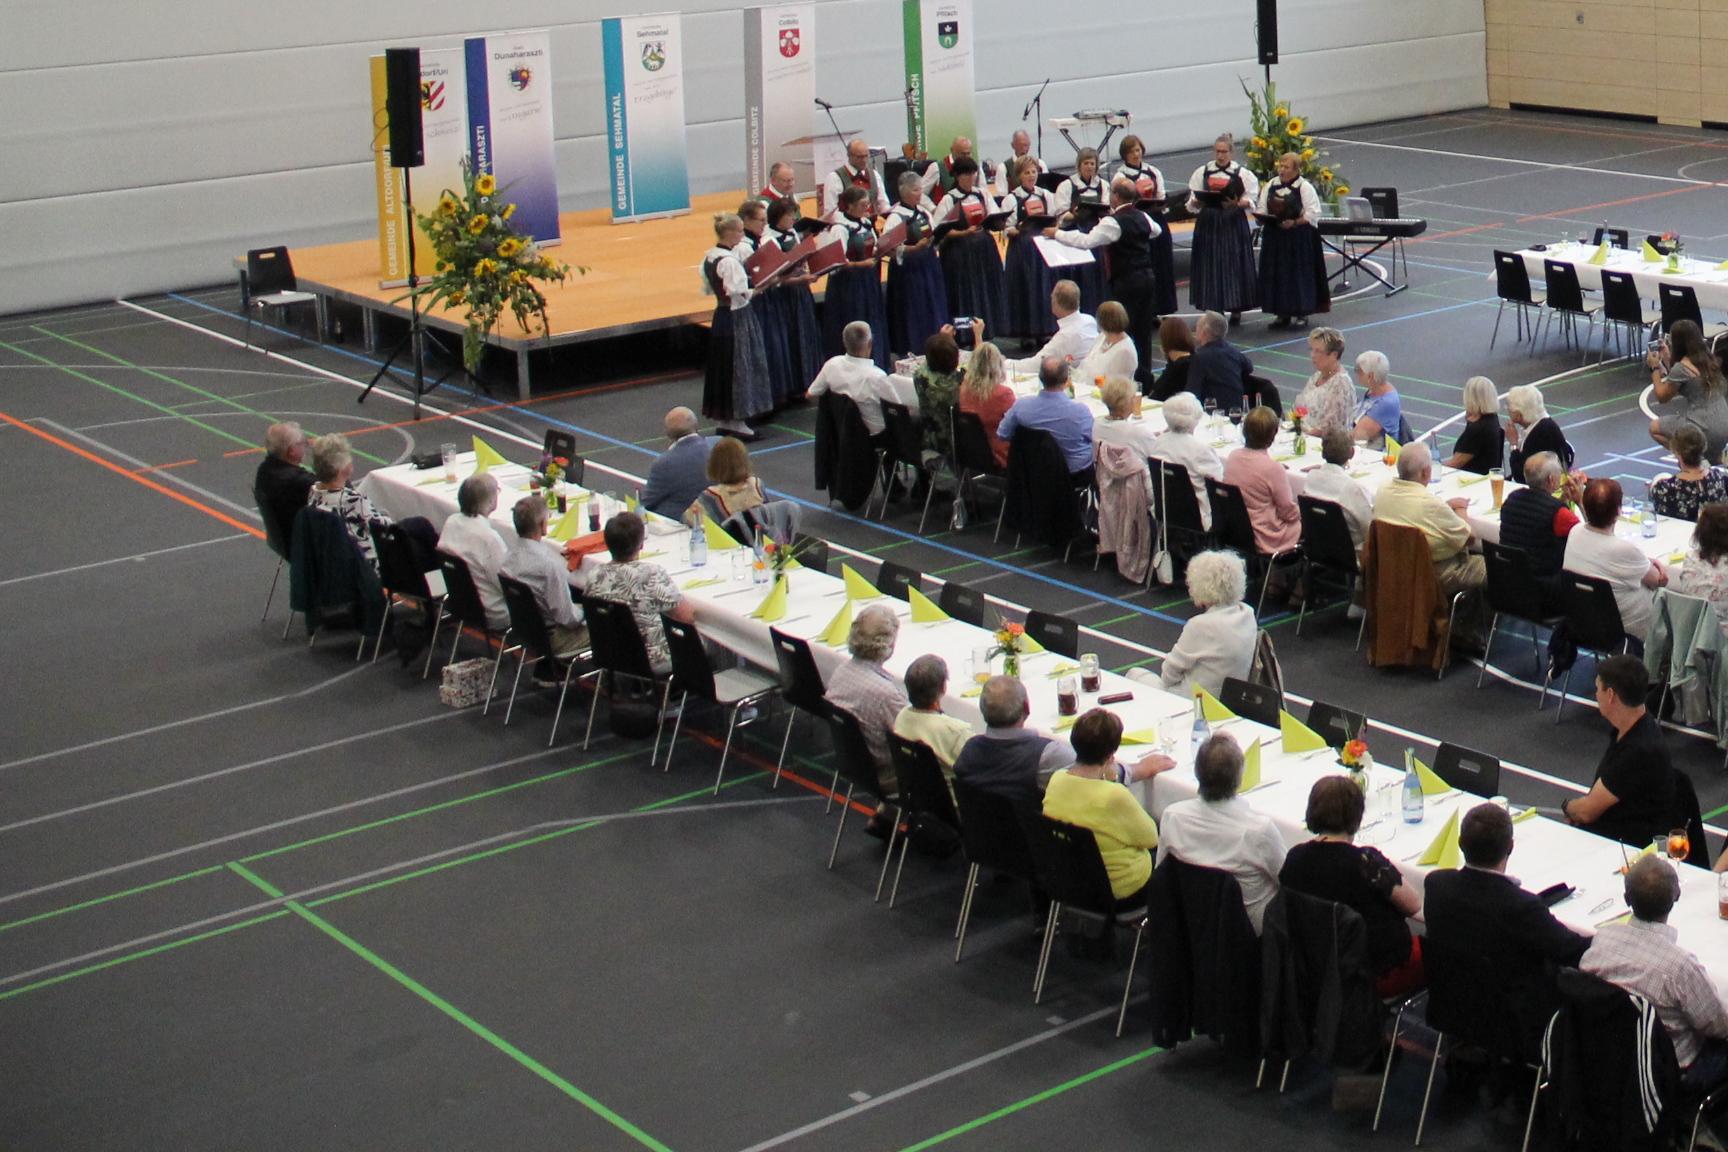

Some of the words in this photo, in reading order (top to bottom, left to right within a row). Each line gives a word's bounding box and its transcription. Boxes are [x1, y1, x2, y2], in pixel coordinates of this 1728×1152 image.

[612, 93, 624, 149] SEHMATAL
[751, 105, 759, 145] COLBITZ
[616, 154, 627, 210] GEMEINDE
[752, 147, 760, 196] GEMEINDE
[387, 220, 398, 276] GEMEINDE
